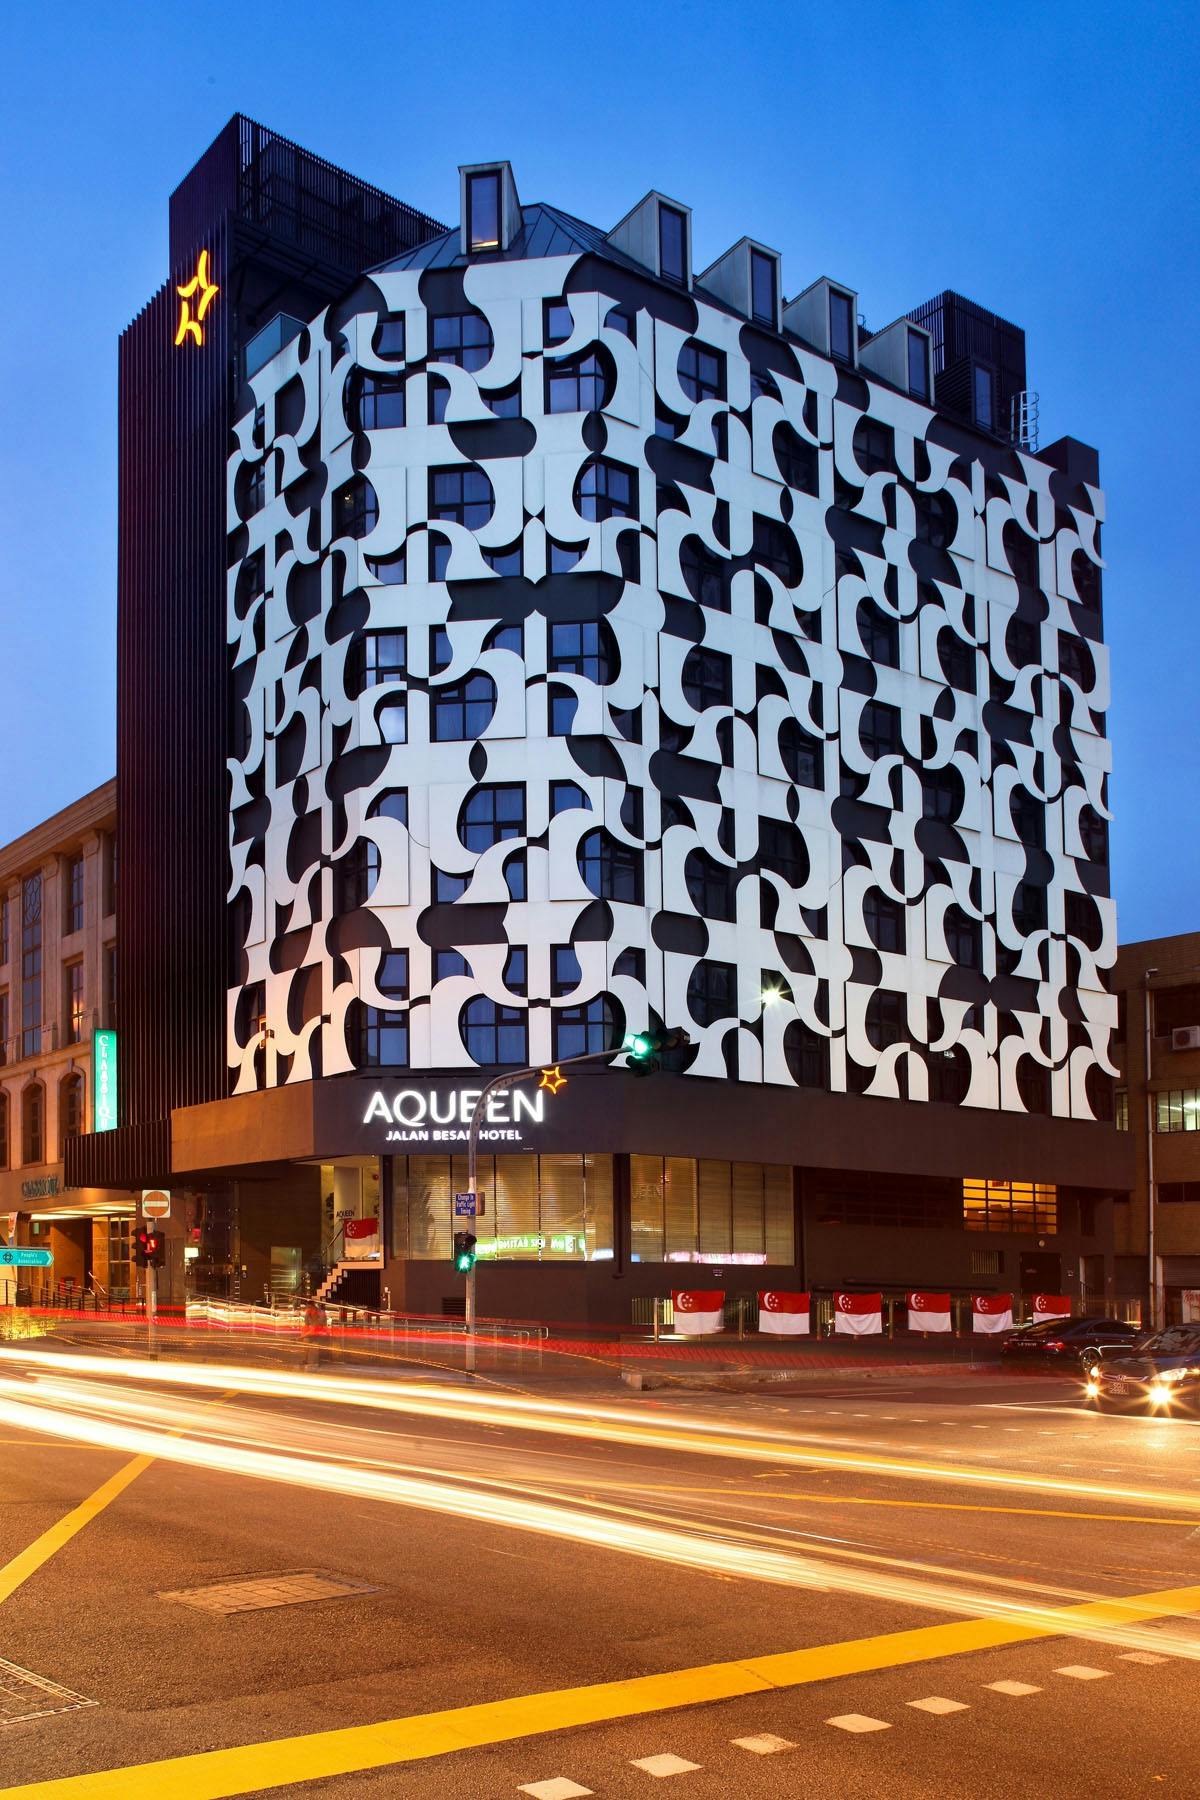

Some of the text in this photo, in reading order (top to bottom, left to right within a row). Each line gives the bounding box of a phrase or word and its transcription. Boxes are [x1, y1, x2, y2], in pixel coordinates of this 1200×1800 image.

[363, 1090, 545, 1127] AQUEEN
[385, 1130, 428, 1141] JALAN
[479, 1130, 523, 1141] HOTEL
